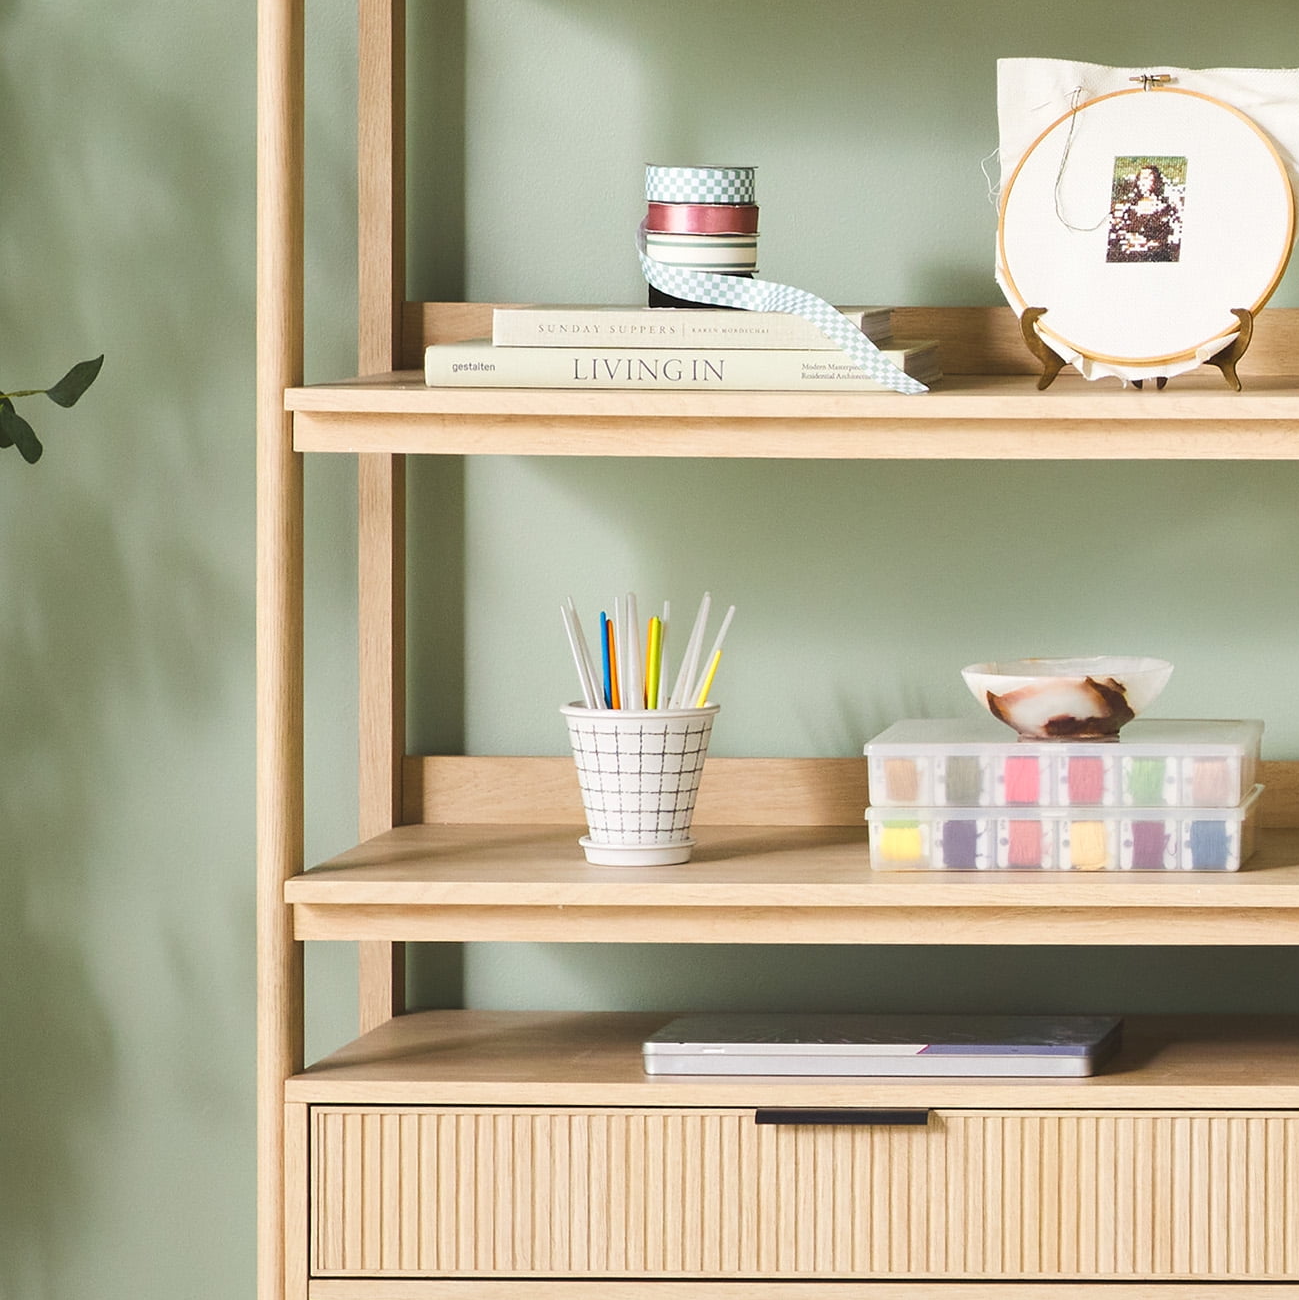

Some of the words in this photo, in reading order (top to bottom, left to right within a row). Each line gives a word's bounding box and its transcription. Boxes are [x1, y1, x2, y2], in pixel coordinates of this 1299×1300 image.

[538, 324, 601, 334] SUNDAY
[609, 325, 676, 334] SUPPERS
[452, 362, 496, 372] gestalten
[574, 358, 683, 382] LIVING
[691, 358, 726, 382] IN
